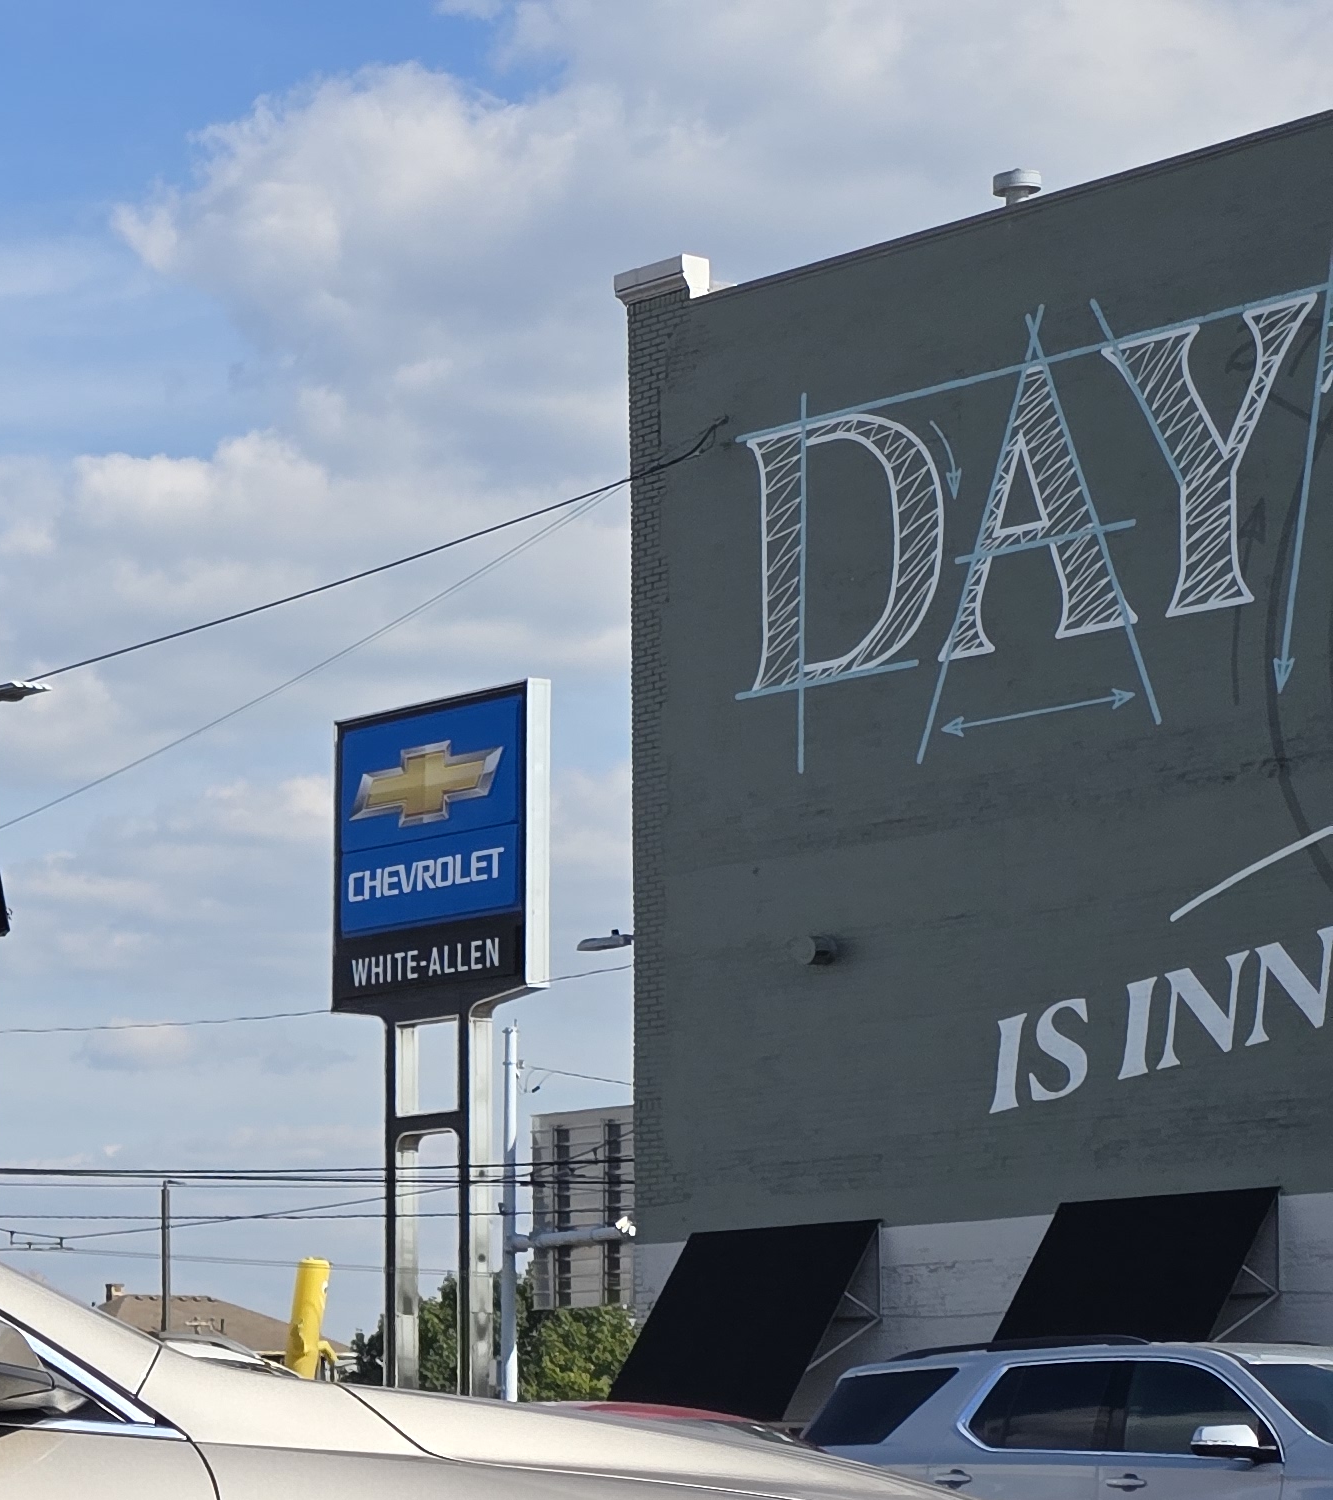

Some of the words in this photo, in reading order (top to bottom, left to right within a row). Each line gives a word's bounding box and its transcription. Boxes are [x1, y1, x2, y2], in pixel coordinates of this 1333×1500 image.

[746, 290, 1333, 692] DAY
[347, 846, 505, 903] CHEVROLET
[351, 937, 500, 987] WHITE-ALLEN
[988, 997, 1089, 1114] IS
[1117, 925, 1333, 1080] INN
